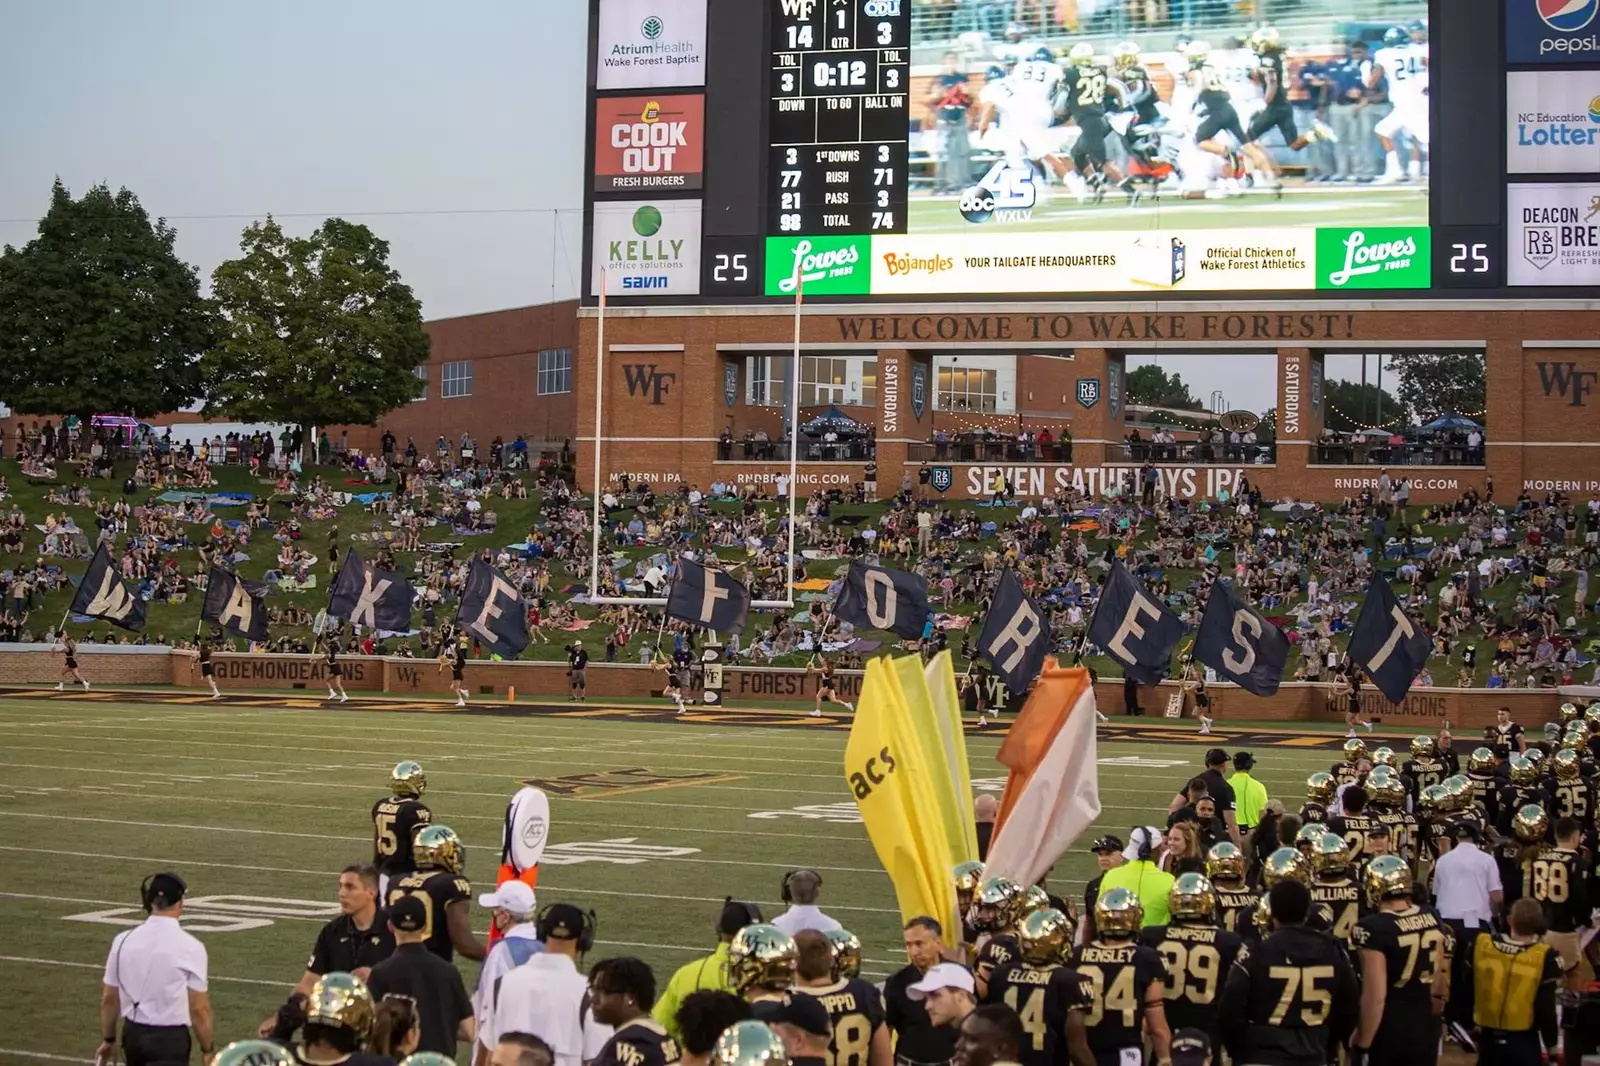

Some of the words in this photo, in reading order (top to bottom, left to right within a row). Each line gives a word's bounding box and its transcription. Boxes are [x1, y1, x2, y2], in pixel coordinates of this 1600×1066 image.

[780, 0, 816, 21] WF
[864, 0, 901, 17] ODU
[836, 9, 846, 30] 1
[786, 25, 813, 49] 14
[831, 37, 849, 49] QTR
[877, 22, 892, 45] 3
[612, 43, 653, 55] Atrium
[655, 40, 693, 53] Health
[1540, 35, 1596, 55] pepsi
[604, 58, 631, 67] Wake
[633, 57, 663, 66] Forest
[666, 54, 700, 66] Baptist
[779, 55, 796, 66] TOL
[884, 51, 901, 62] TOL
[814, 60, 867, 87] 0:12
[886, 69, 899, 88] 3
[1395, 57, 1415, 80] 24
[781, 73, 794, 92] 3
[1076, 75, 1107, 105] 28
[779, 99, 805, 112] DOWN
[826, 98, 839, 110] TO
[840, 98, 852, 109] GO
[865, 97, 888, 109] BALL
[890, 96, 903, 108] ON
[1518, 113, 1534, 123] NC
[1536, 113, 1586, 123] Education
[611, 121, 688, 148] COOK
[1518, 124, 1600, 146] Lotter
[622, 147, 676, 173] OUT
[786, 148, 798, 165] 3
[828, 150, 860, 163] DOWNS
[877, 145, 890, 163] 3
[613, 177, 641, 187] FRESH
[643, 175, 685, 186] BURGERS
[781, 170, 802, 188] 77
[826, 171, 849, 183] RUSH
[873, 168, 894, 186] 71
[781, 192, 801, 210] 21
[825, 192, 849, 204] PASS
[877, 190, 889, 207] 3
[959, 197, 995, 212] abc
[780, 214, 802, 231] 98
[823, 214, 850, 227] TOTAL
[872, 212, 894, 229] 74
[994, 209, 1033, 223] WXLV
[1523, 207, 1579, 223] DEACON
[609, 239, 684, 261] KELLY
[1207, 247, 1242, 259] Official
[1245, 246, 1283, 258] Chicken
[1286, 247, 1297, 257] of
[1329, 230, 1417, 286] Lowes
[1451, 243, 1489, 273] 25
[609, 261, 637, 270] office
[639, 260, 684, 269] solutions
[713, 253, 747, 281] 25
[778, 239, 859, 292] Lowes
[883, 252, 954, 276] Bojangles
[965, 256, 991, 268] YOUR
[993, 255, 1037, 268] TAILGATE
[1039, 254, 1117, 267] HEADQUARTERS
[1200, 260, 1226, 270] Wake
[1228, 259, 1259, 270] Forest
[1262, 257, 1306, 270] Athletics
[623, 276, 668, 288] savin
[838, 316, 1013, 340] WELCOME
[1026, 316, 1073, 339] TO
[1087, 315, 1187, 339] WAKE
[1202, 314, 1354, 338] FOREST!
[622, 364, 676, 406] WF
[1536, 361, 1599, 407] WF
[883, 364, 898, 433] SATURDAYS
[1285, 363, 1300, 434] SATURDAYS
[663, 473, 681, 483] IPA
[1523, 479, 1581, 491] MODERN
[85, 566, 136, 621] W
[349, 569, 393, 628] K
[699, 566, 729, 623] F
[864, 568, 897, 630] O
[218, 577, 253, 633] A
[470, 574, 519, 644] E
[988, 598, 1041, 674] R
[1107, 590, 1162, 666] E
[1367, 603, 1415, 673] T
[1221, 608, 1263, 676] S
[397, 666, 425, 688] WF
[705, 668, 719, 684] WF
[740, 673, 806, 695] FOREST
[850, 745, 896, 800] acs
[1555, 785, 1588, 818] 35
[1344, 818, 1370, 830] FIELDS
[1311, 887, 1358, 901] WILLIAMS
[1395, 913, 1438, 933] VAUGHAN
[1165, 927, 1217, 943] SIMPSON
[990, 944, 1012, 965] WF
[1081, 948, 1137, 964] HENSLEY
[1393, 929, 1444, 989] 73
[1007, 970, 1053, 986] ELLISON
[1156, 941, 1221, 1004] 39
[1076, 965, 1137, 1027] 34
[1268, 965, 1334, 1026] 75
[1004, 986, 1047, 1051] 14
[616, 1042, 644, 1066] WF
